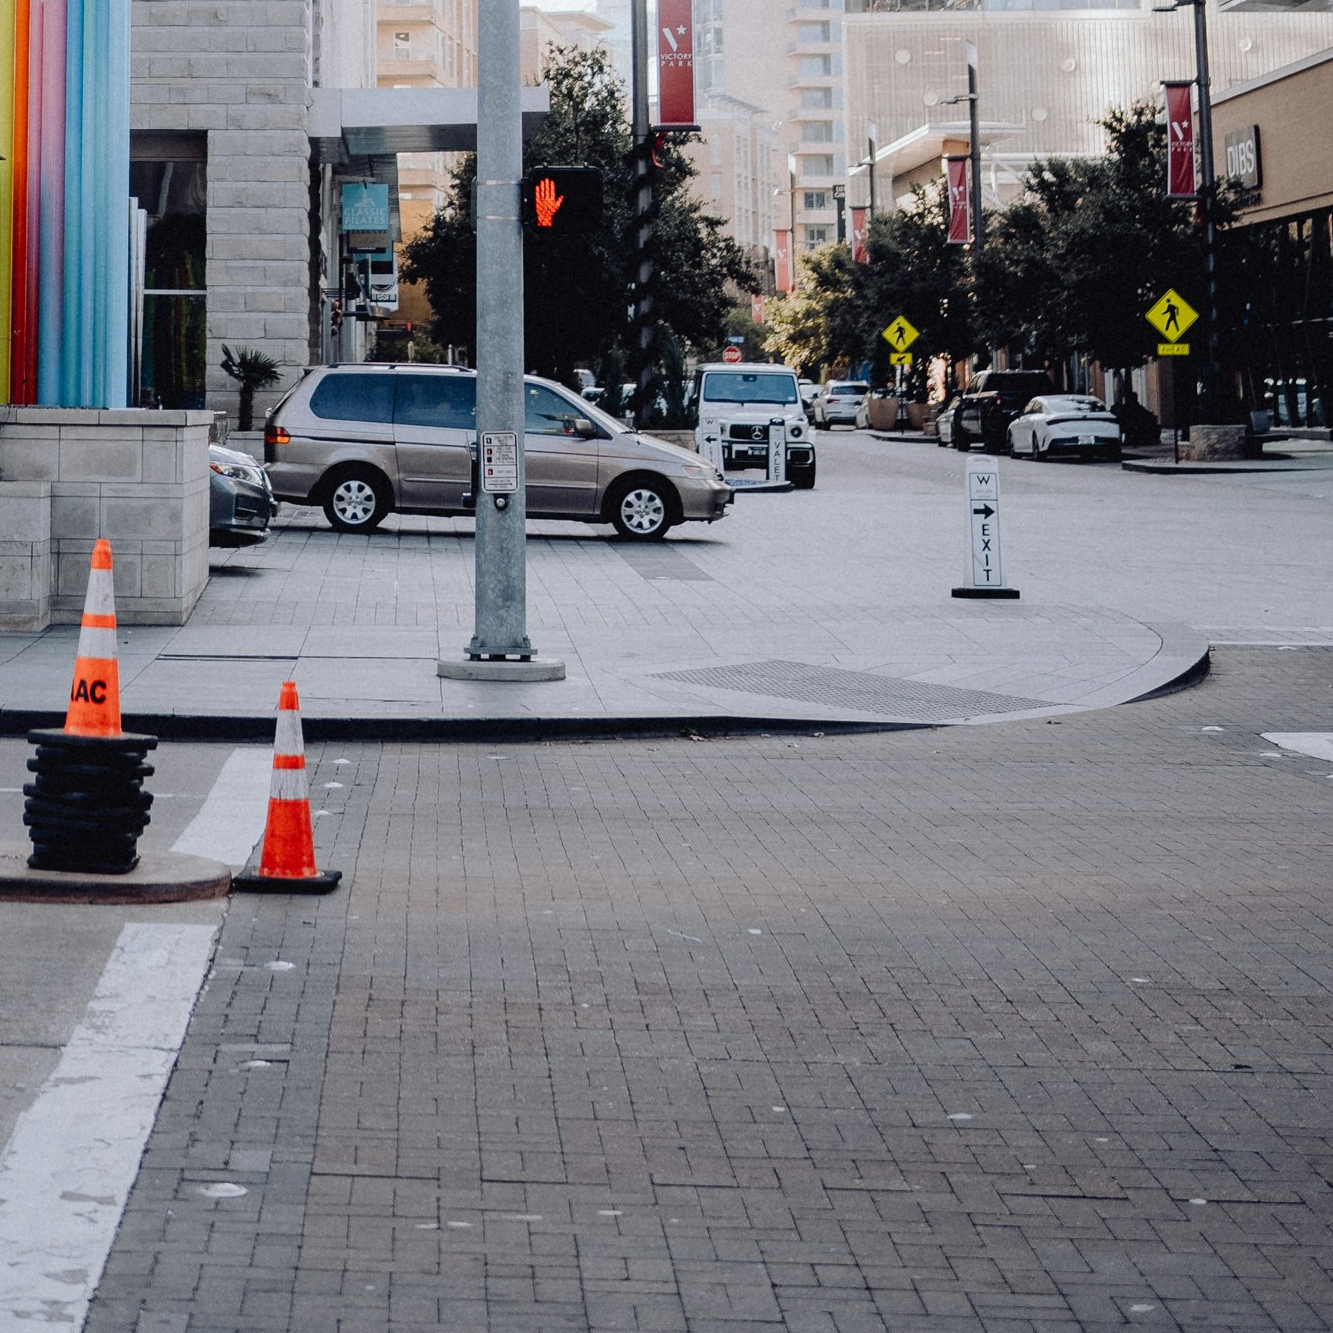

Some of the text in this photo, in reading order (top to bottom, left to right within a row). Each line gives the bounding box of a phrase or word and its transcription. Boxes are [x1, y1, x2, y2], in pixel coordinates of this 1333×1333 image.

[660, 53, 693, 61] VICTORY
[661, 60, 693, 68] PARK
[1227, 139, 1255, 179] DIBS
[344, 207, 386, 216] CLASSIC
[345, 216, 386, 225] PILATES
[723, 351, 741, 360] STOP
[773, 441, 781, 482] VALET
[976, 475, 991, 486] W
[981, 523, 992, 582] EXIT
